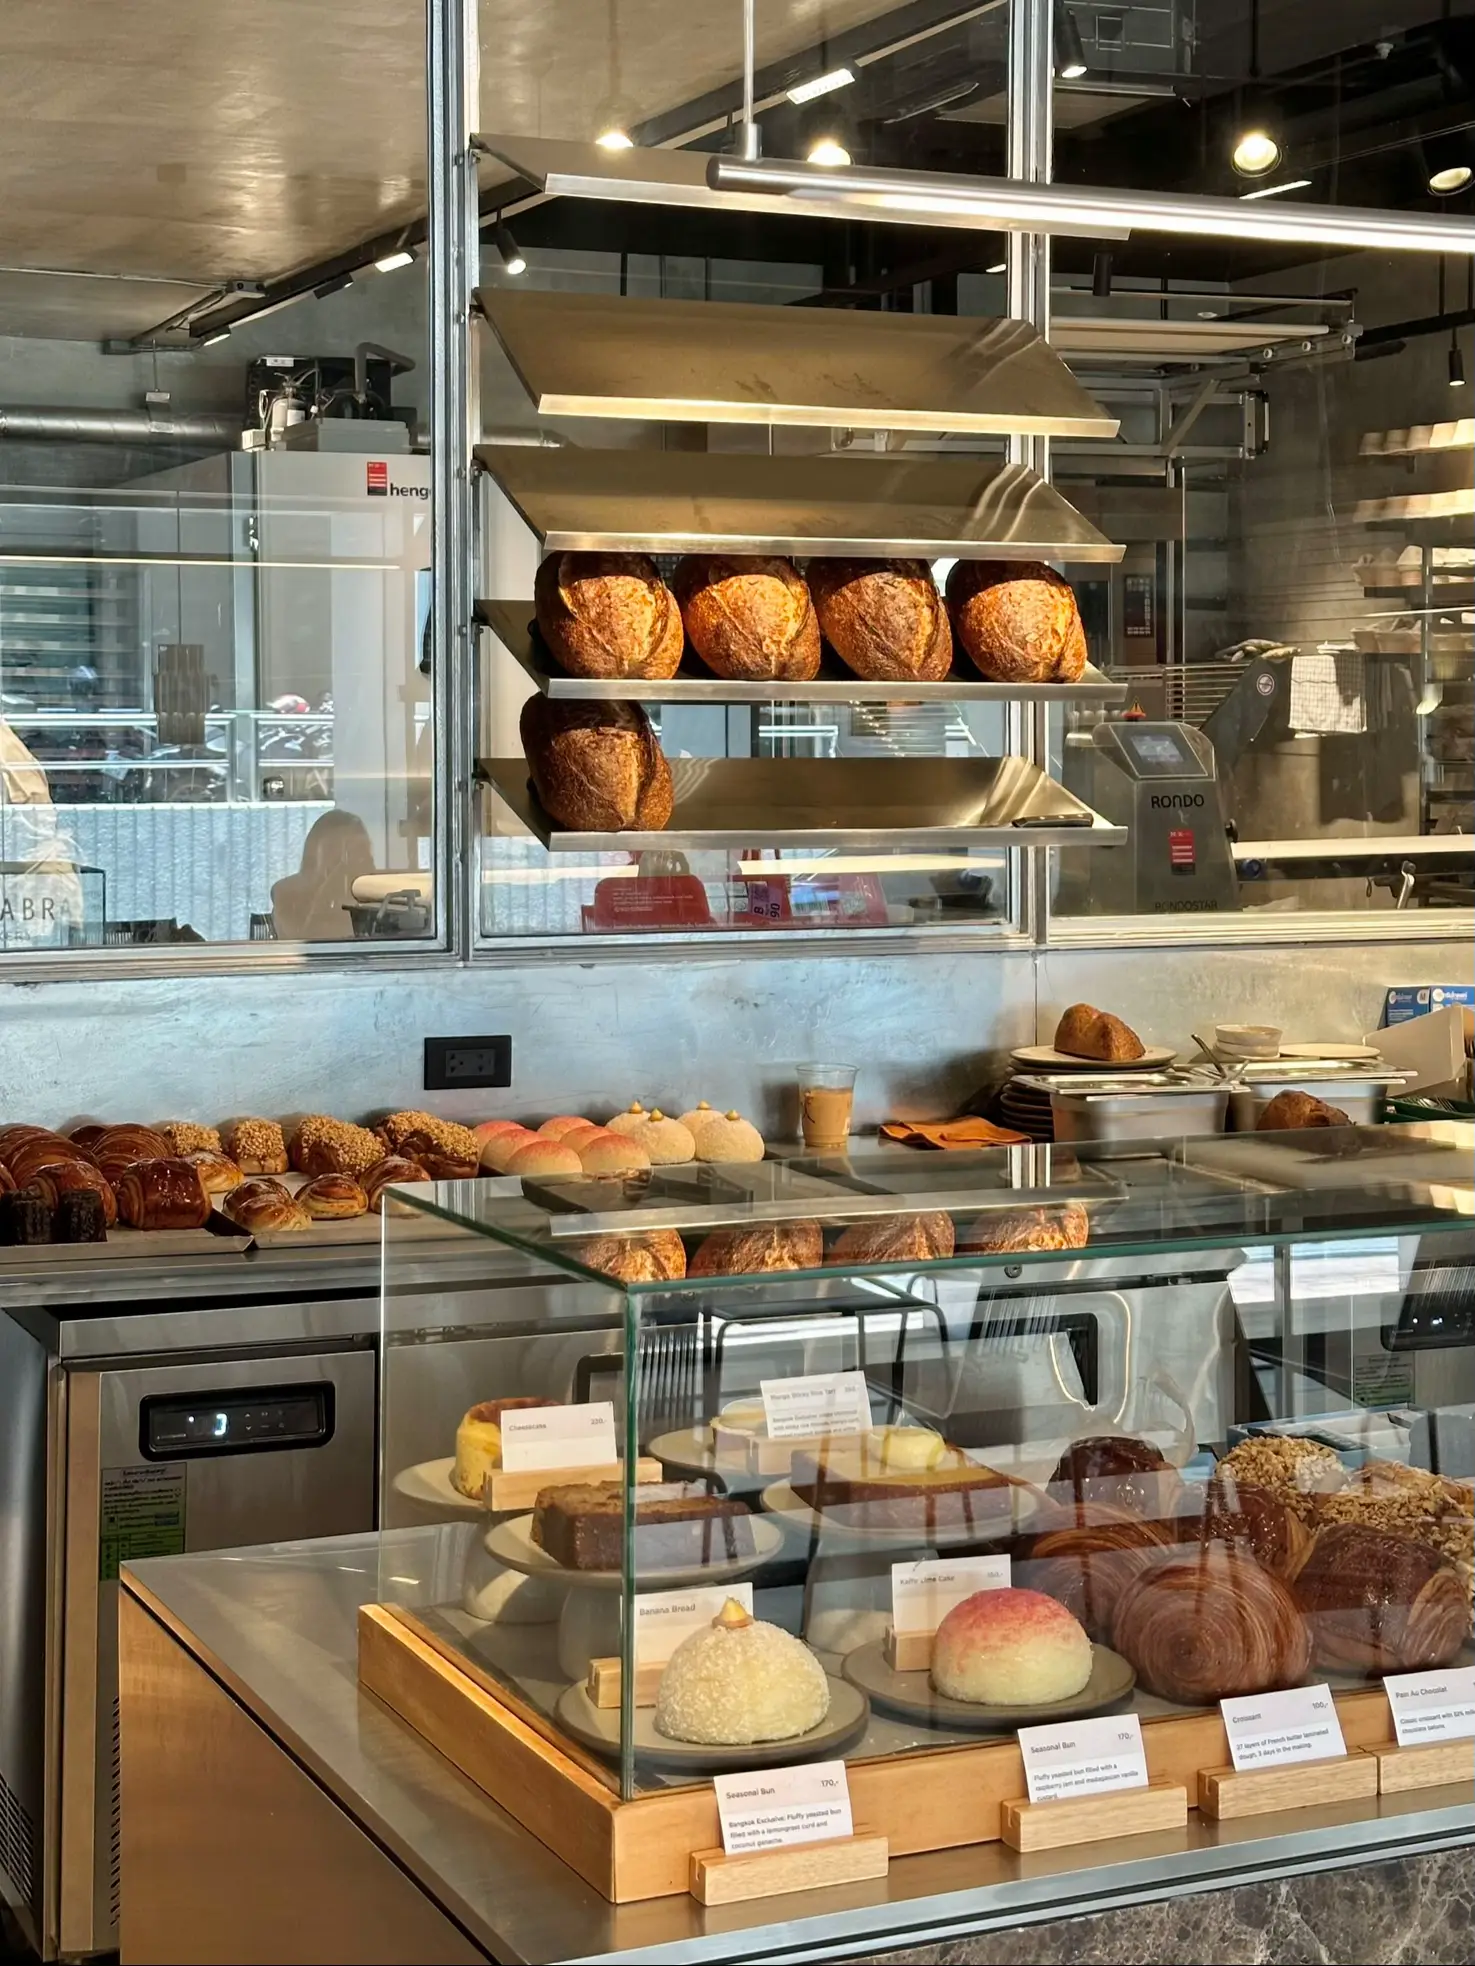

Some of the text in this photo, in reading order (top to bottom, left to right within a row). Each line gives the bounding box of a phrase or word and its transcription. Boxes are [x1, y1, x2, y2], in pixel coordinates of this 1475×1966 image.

[390, 482, 431, 500] heng
[1151, 794, 1205, 809] RONDO
[639, 1603, 696, 1616] Banana Bread
[1395, 1685, 1447, 1699] Pain Au Chocolat
[1232, 1713, 1262, 1724] Croissant
[1236, 1728, 1329, 1751] 27 layers of French butter laminated
[1030, 1741, 1076, 1754] Seasonal Bun
[1263, 1748, 1275, 1757] days
[1282, 1744, 1292, 1752] the
[1033, 1773, 1050, 1782] Fluffy
[1073, 1768, 1085, 1776] bun
[1085, 1766, 1100, 1774] filled
[1100, 1763, 1112, 1772] with
[1062, 1780, 1074, 1789] jam
[1074, 1778, 1085, 1786] and
[1121, 1770, 1139, 1778] vanilla
[726, 1787, 775, 1800] Seasonal Bun
[728, 1818, 755, 1829] Bangkok
[787, 1812, 804, 1821] Fluffy
[805, 1810, 829, 1820] yeasted
[829, 1807, 842, 1816] bun
[730, 1831, 746, 1839] filled
[747, 1829, 760, 1837] with
[766, 1824, 801, 1834] lemongrass
[801, 1821, 815, 1830] curd
[816, 1820, 828, 1828] and
[731, 1840, 756, 1850] coconut
